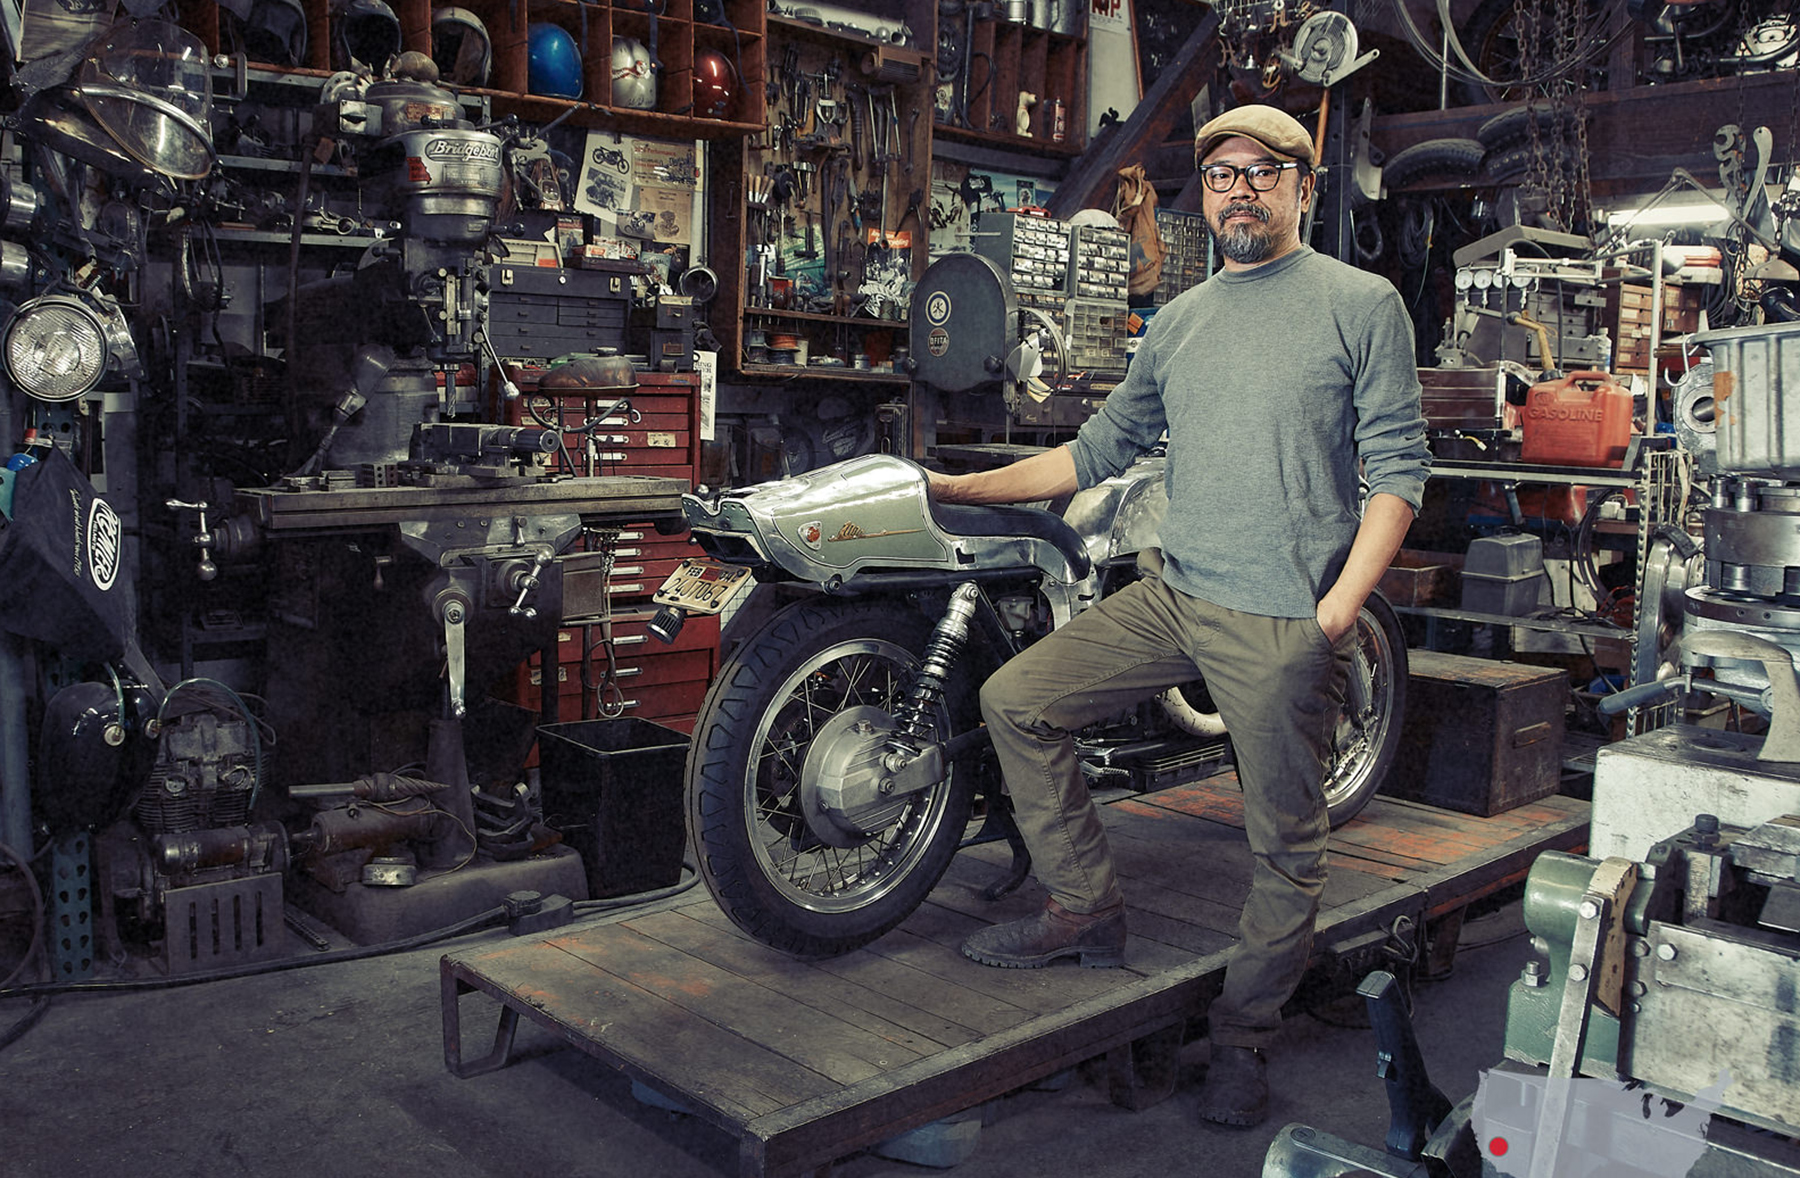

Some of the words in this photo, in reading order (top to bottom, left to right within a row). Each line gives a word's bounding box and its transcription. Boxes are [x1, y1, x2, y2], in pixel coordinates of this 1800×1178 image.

[431, 141, 499, 161] Bridgeport
[1528, 407, 1604, 422] GASOLINE
[94, 502, 118, 582] PREMIER
[686, 566, 703, 577] FEB
